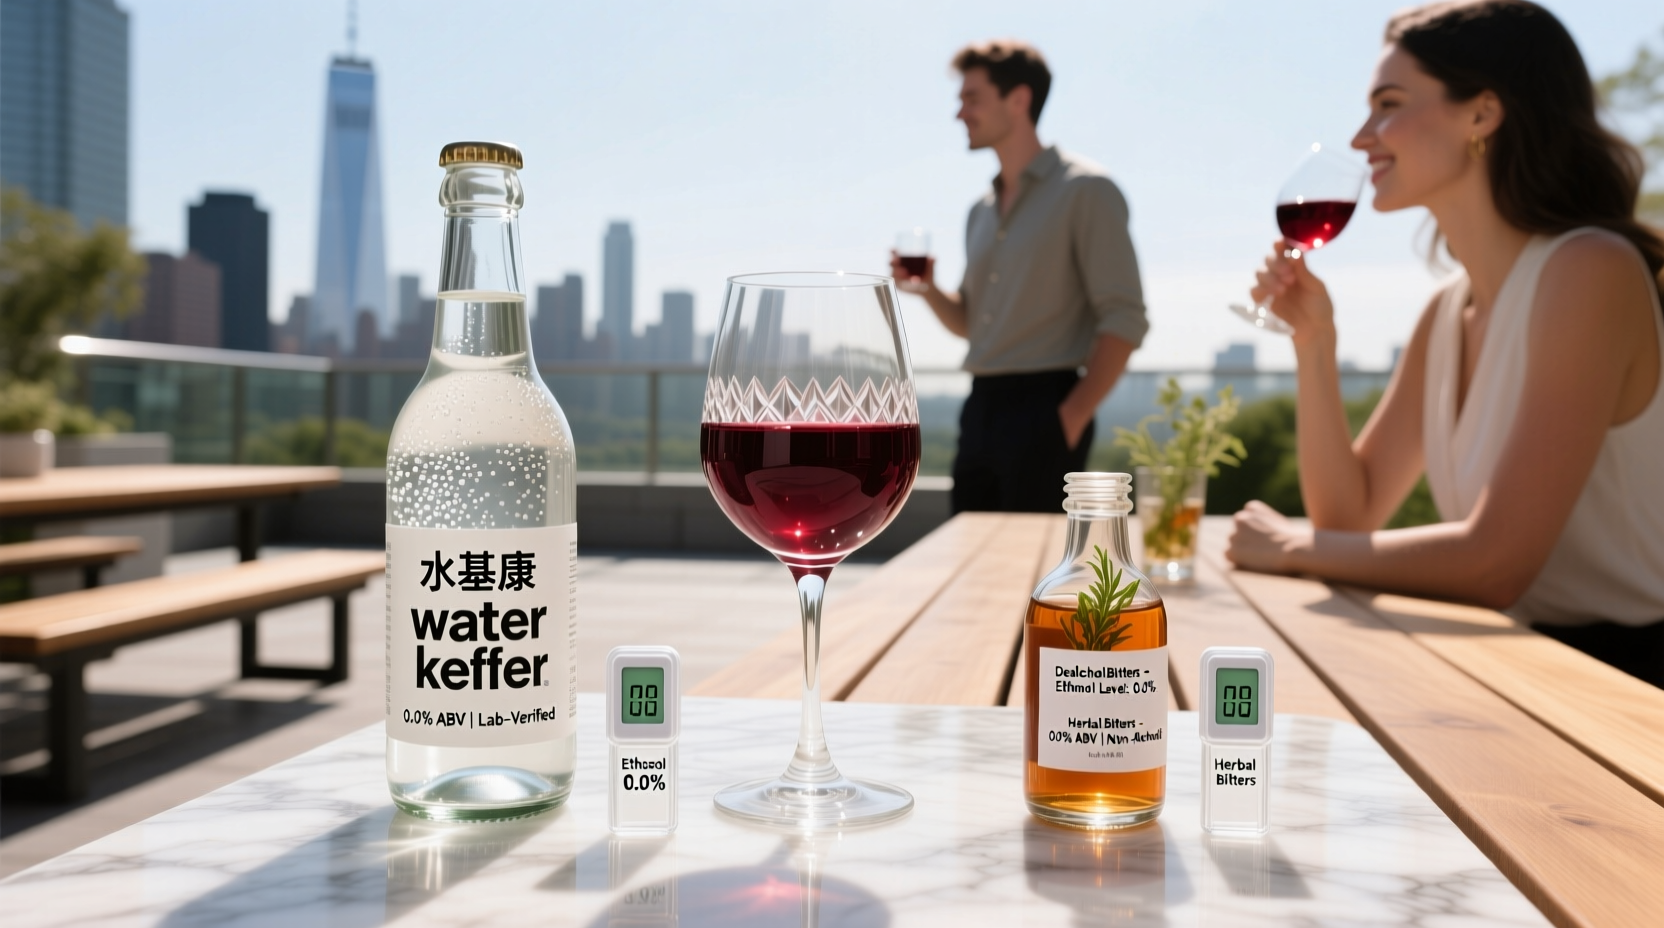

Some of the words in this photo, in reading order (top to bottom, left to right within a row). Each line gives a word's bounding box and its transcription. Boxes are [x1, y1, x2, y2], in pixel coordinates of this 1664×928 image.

[420, 550, 536, 592] 水基康
[410, 602, 547, 642] water
[416, 645, 549, 690] keffer
[403, 708, 433, 725] 0.0%
[436, 712, 466, 727] ABV
[478, 706, 556, 727] Lab-Verified
[1214, 757, 1256, 771] Herbal
[623, 773, 666, 791] 0.0%
